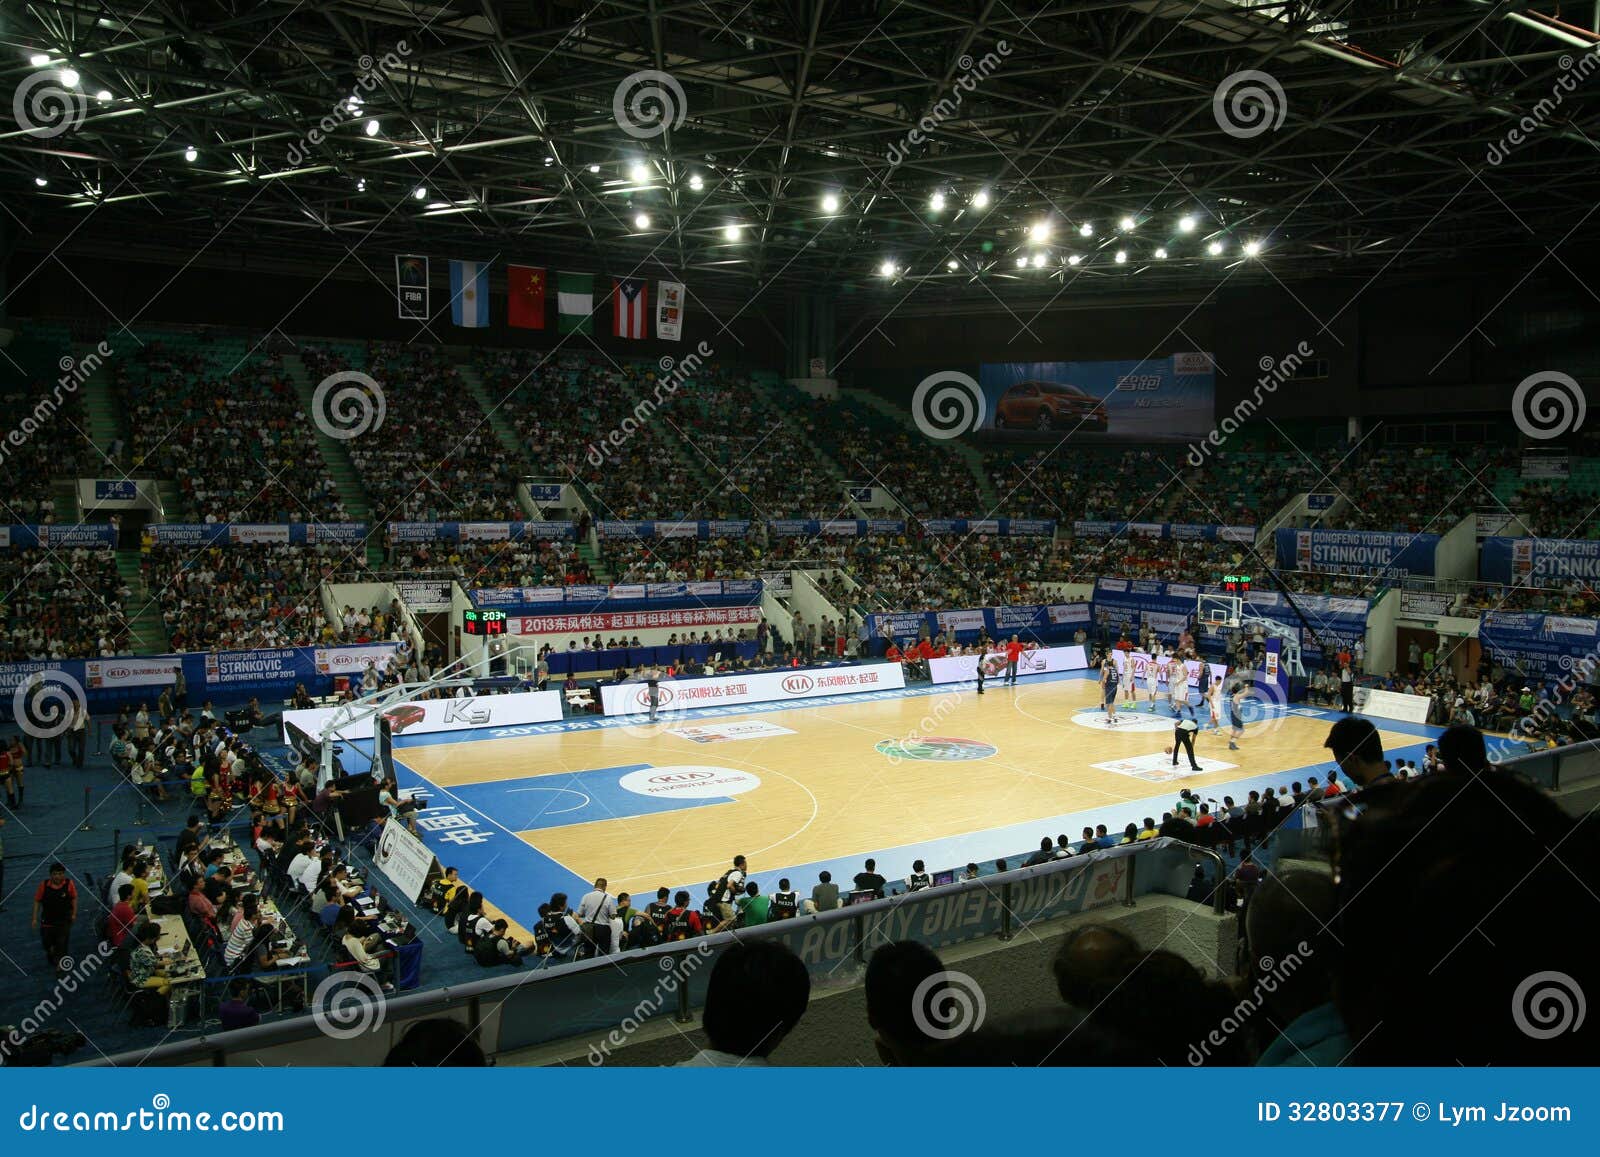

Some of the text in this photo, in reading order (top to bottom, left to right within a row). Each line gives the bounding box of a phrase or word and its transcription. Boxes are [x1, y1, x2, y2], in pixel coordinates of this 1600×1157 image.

[405, 292, 421, 301] FIBA
[49, 531, 98, 541] STANKOVIC
[1313, 531, 1410, 547] DONGFENG YUEDA KIA
[1313, 545, 1392, 565] STANKOVIC
[1387, 568, 1409, 578] 2013
[482, 611, 506, 621] 2034
[487, 620, 501, 635] 14
[219, 652, 257, 663] DONGFENG
[258, 651, 281, 660] YUEDA
[17, 663, 46, 672] YUEDA
[220, 659, 282, 674] STANKOVIC
[110, 669, 127, 677] KIA
[221, 670, 296, 682] CONTINENTAL CUP 2013
[786, 672, 879, 691] KIA 东风悦达·起亚
[677, 684, 748, 701] 东风悦达·起亚
[443, 699, 491, 725] K3
